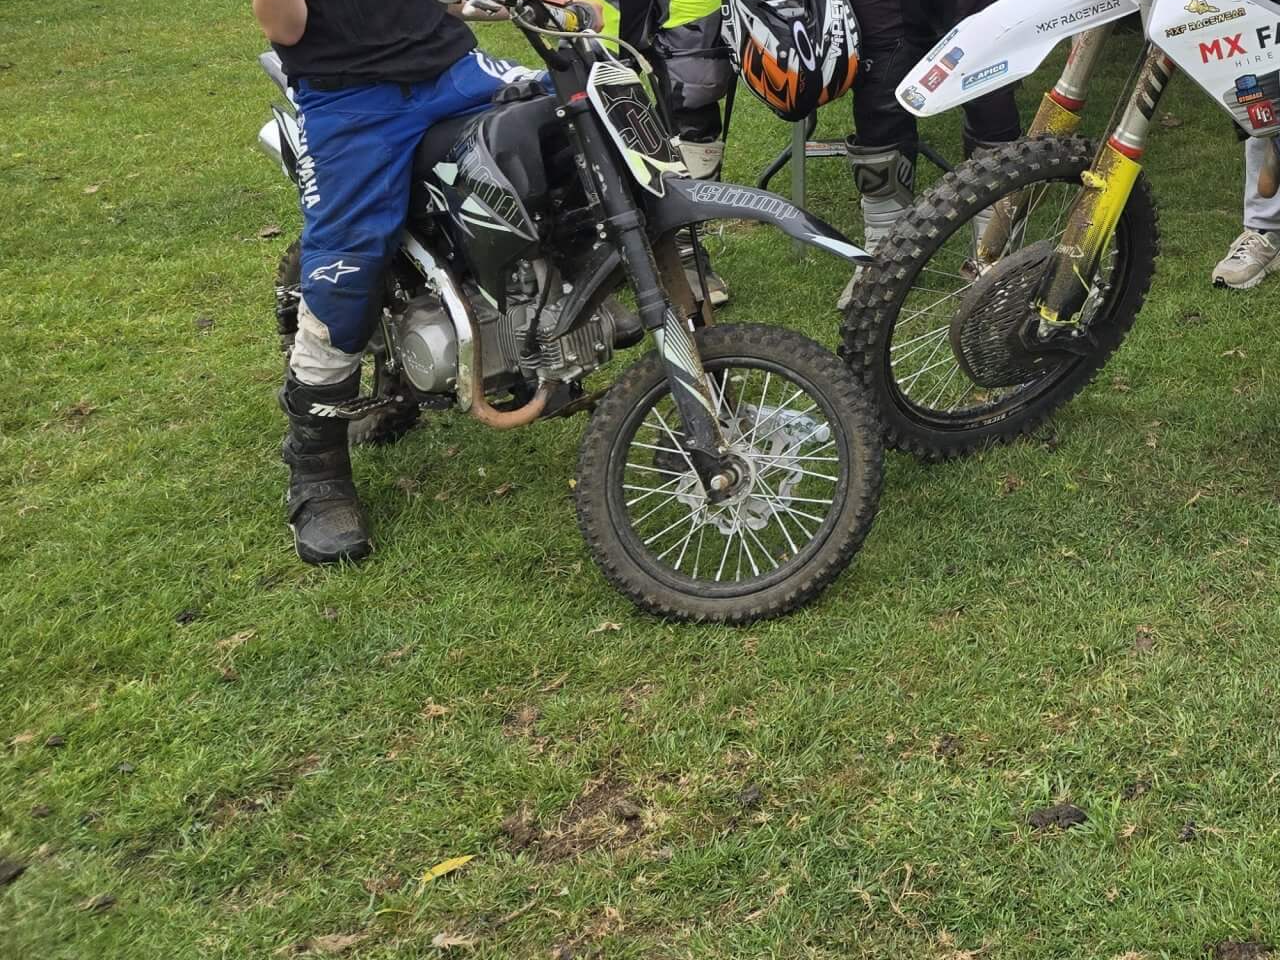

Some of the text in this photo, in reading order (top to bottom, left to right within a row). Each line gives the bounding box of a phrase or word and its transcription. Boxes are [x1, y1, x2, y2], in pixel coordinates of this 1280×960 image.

[1035, 19, 1059, 34] MXF
[1188, 7, 1247, 31] RACEWEAR
[1198, 33, 1247, 64] MX
[1235, 52, 1273, 68] HIRE
